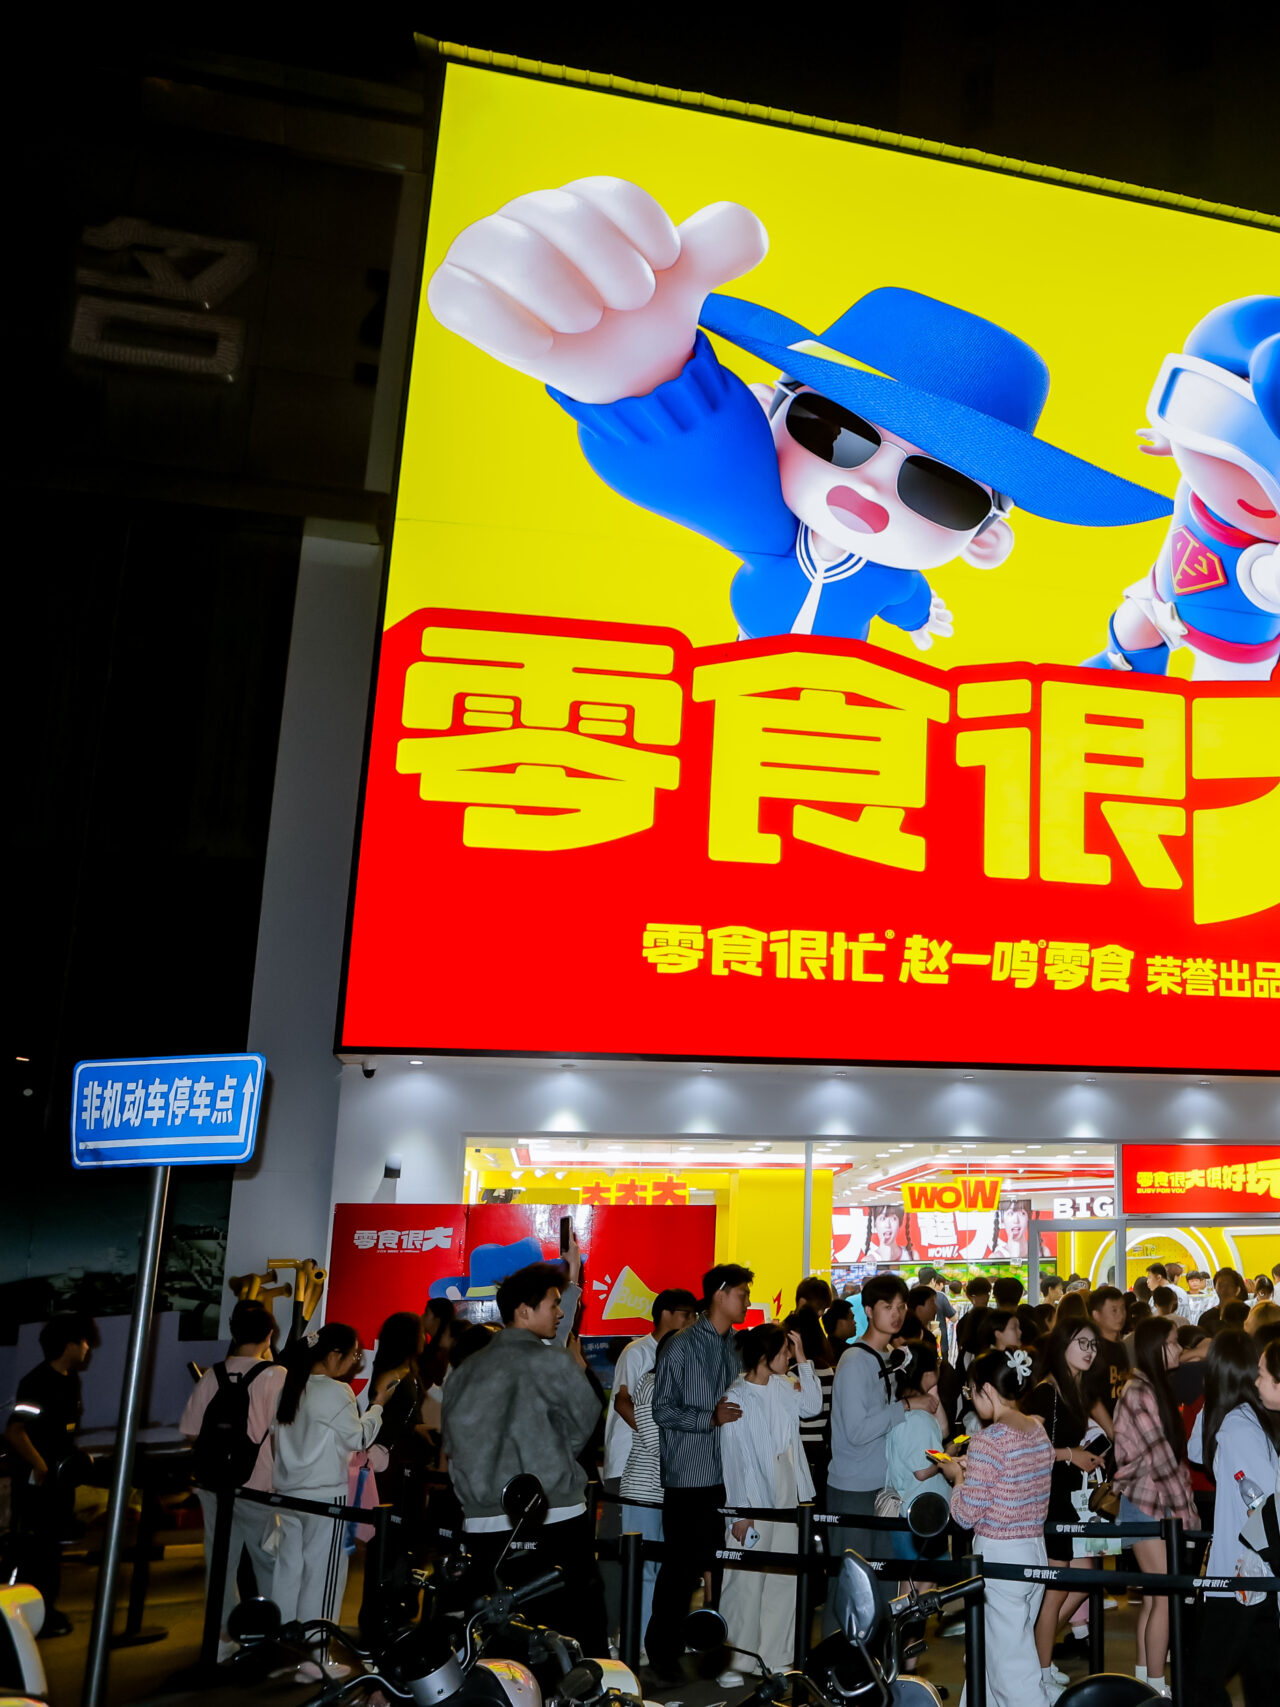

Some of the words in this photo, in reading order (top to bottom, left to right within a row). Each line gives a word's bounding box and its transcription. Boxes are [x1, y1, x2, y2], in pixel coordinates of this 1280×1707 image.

[642, 922, 886, 982] 零食很忙
[898, 934, 1134, 992] 赵一鸣零食
[81, 1074, 237, 1130] 非机动车停车点
[908, 1180, 999, 1209] WOW
[1053, 1197, 1114, 1219] BIG
[353, 1226, 454, 1252] 零食很大
[1023, 1567, 1058, 1580] 零食很忙
[1192, 1578, 1230, 1588] 零食很忙
